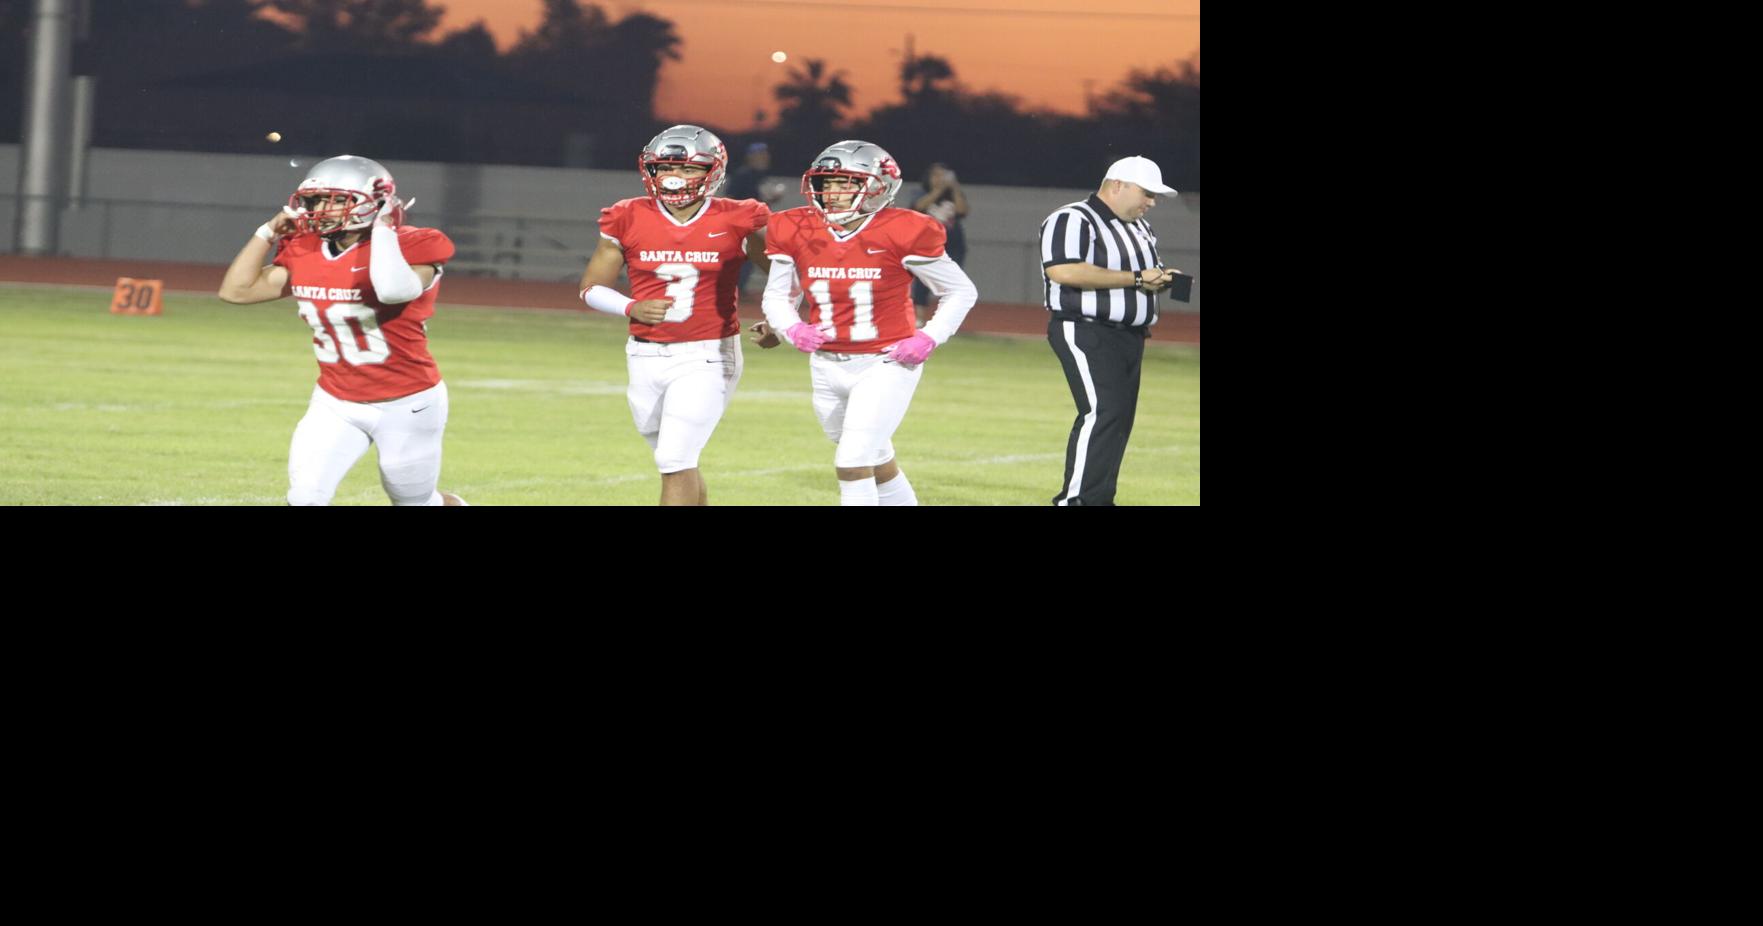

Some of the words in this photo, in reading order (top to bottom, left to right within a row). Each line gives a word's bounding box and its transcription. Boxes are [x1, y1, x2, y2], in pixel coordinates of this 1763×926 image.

[640, 250, 683, 262] SANTA
[685, 251, 719, 263] CRUZ
[808, 267, 846, 279] SANTA
[847, 267, 882, 279] CRUZ
[117, 284, 153, 310] 30
[328, 288, 362, 301] CRUZ
[655, 263, 700, 323] 3
[809, 279, 879, 342] 11
